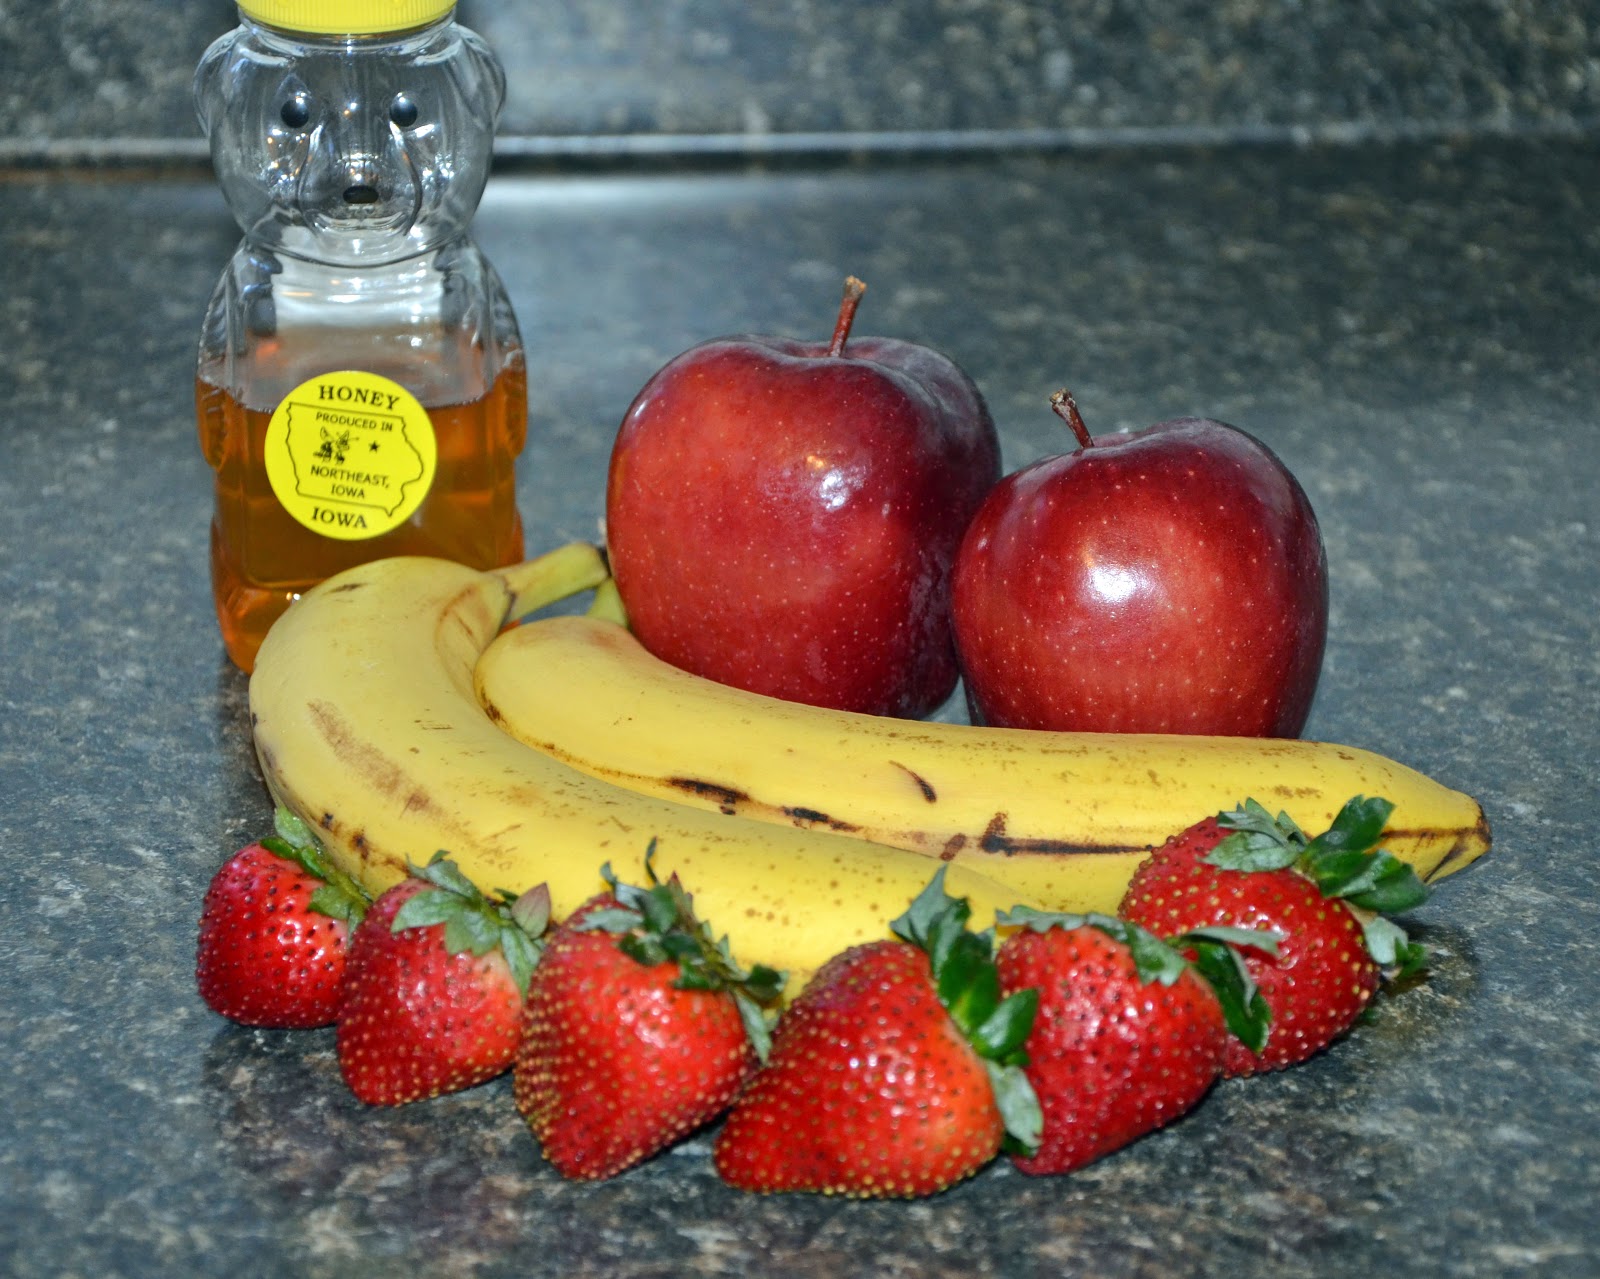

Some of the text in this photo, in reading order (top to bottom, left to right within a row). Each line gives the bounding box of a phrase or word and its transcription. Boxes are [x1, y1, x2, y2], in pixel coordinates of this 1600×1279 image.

[319, 385, 400, 410] HONEY
[315, 411, 393, 432] PRODUCED IN
[310, 464, 390, 489] NORTHEAST,
[331, 483, 365, 499] IOWA
[311, 506, 368, 529] IOWA
